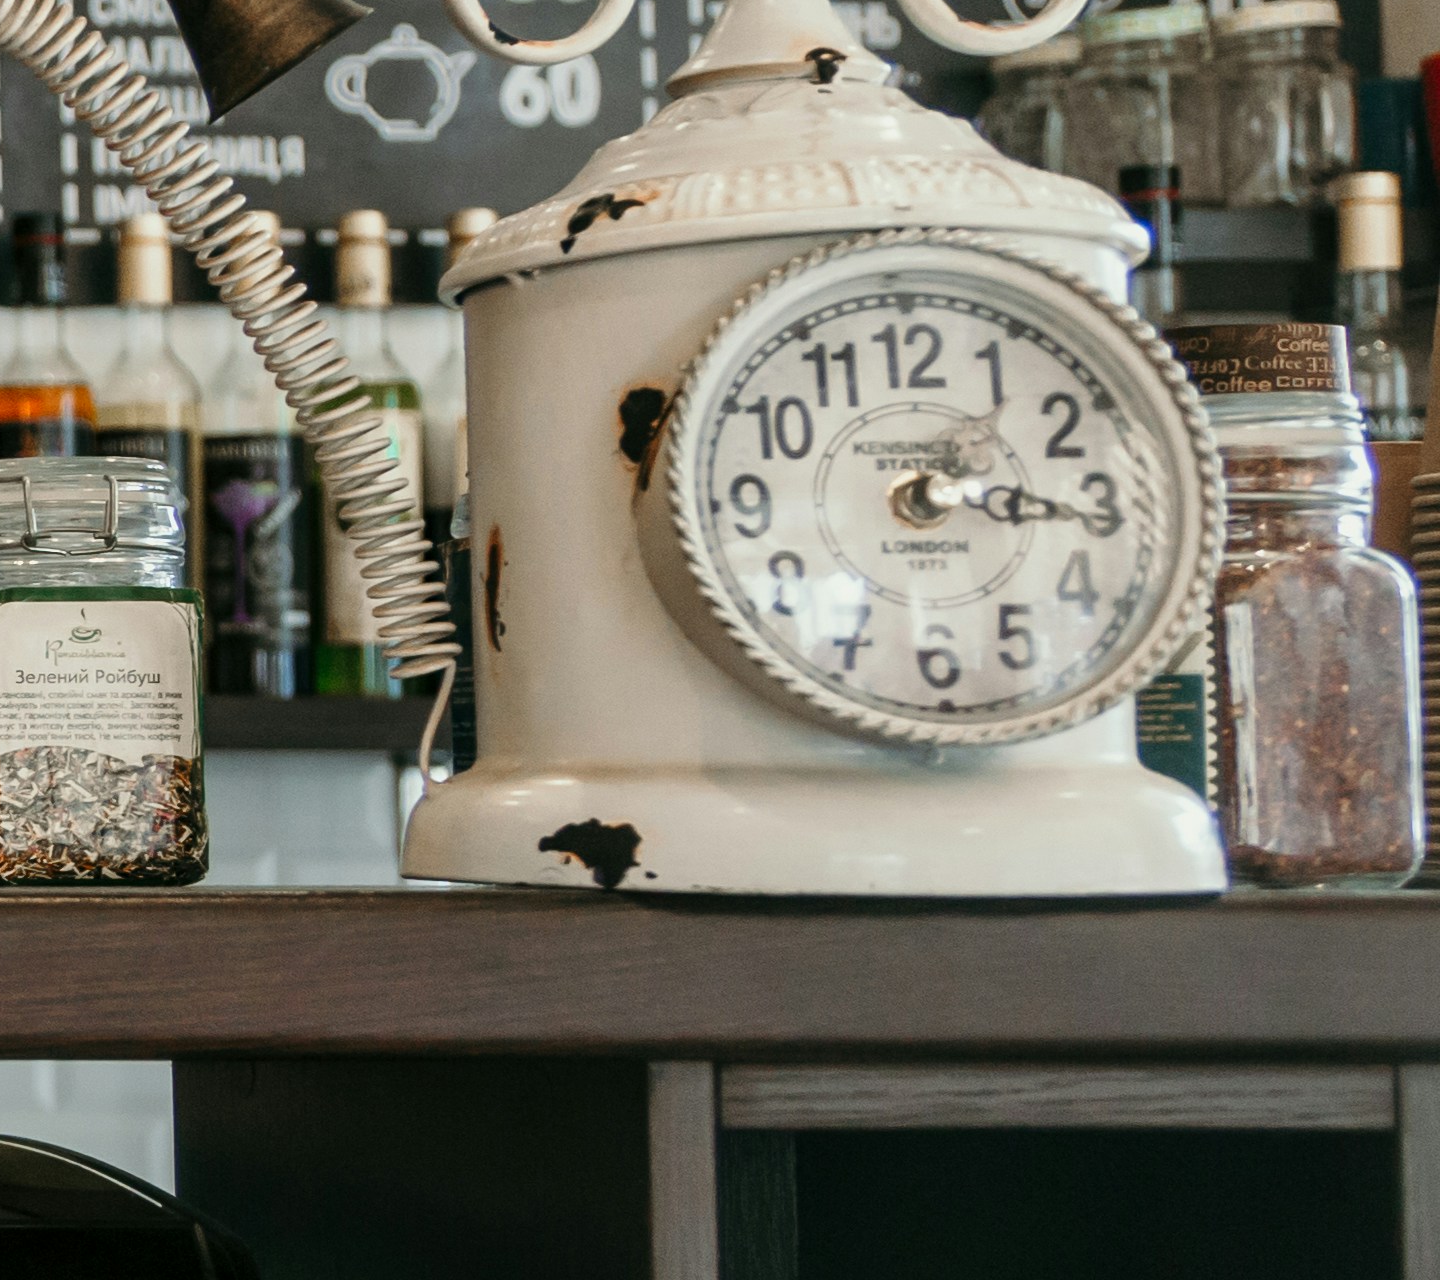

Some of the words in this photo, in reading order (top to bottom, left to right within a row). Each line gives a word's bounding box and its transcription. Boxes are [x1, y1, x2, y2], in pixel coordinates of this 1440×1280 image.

[498, 55, 603, 127] 60
[802, 341, 860, 409] 11
[874, 323, 947, 390] 12
[976, 341, 1005, 406] 1
[1244, 355, 1302, 371] Coffee
[1277, 337, 1330, 353] Coffee
[1199, 375, 1272, 393] Coffee
[747, 393, 815, 461] 10
[1041, 392, 1086, 460] 2
[728, 474, 773, 539] 9
[1081, 471, 1123, 537] 3
[881, 539, 970, 554] LONDON
[1056, 549, 1098, 616] 4
[916, 624, 961, 690] 6
[997, 603, 1037, 671] 5
[15, 670, 89, 684] Зелений
[95, 670, 161, 687] Ройбуш
